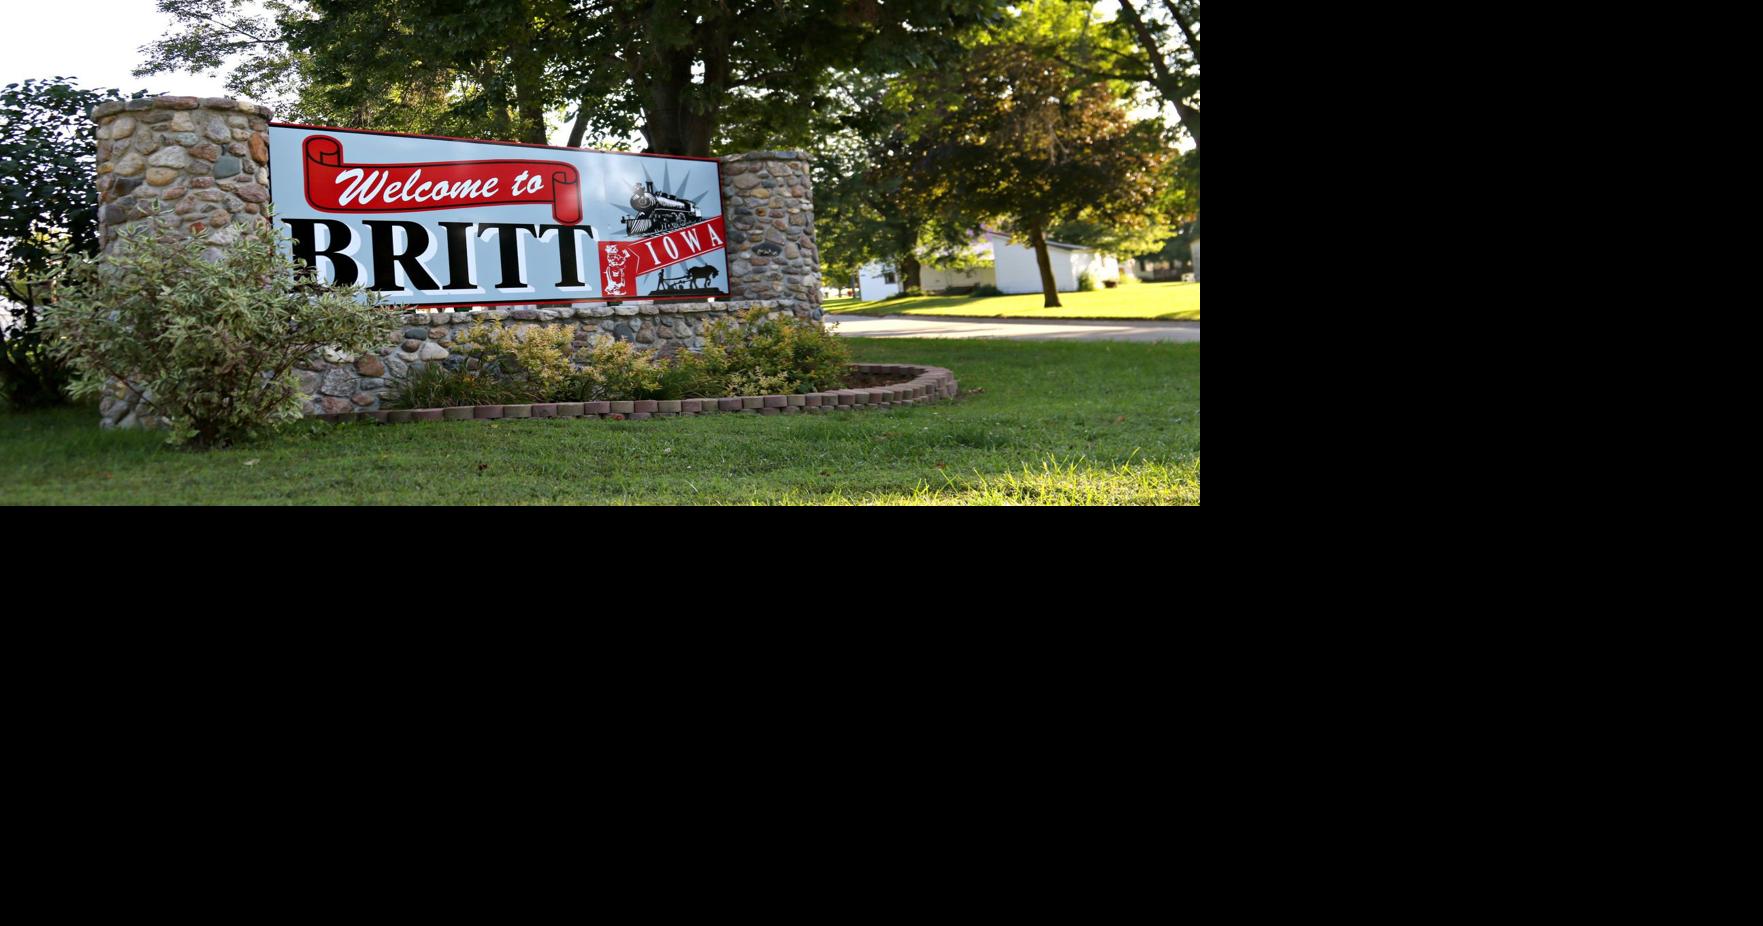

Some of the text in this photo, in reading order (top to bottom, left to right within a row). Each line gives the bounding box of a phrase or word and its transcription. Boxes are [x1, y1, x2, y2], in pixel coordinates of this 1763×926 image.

[335, 168, 544, 206] Welcome to
[281, 218, 594, 291] BRITT
[645, 223, 724, 266] IOWA
